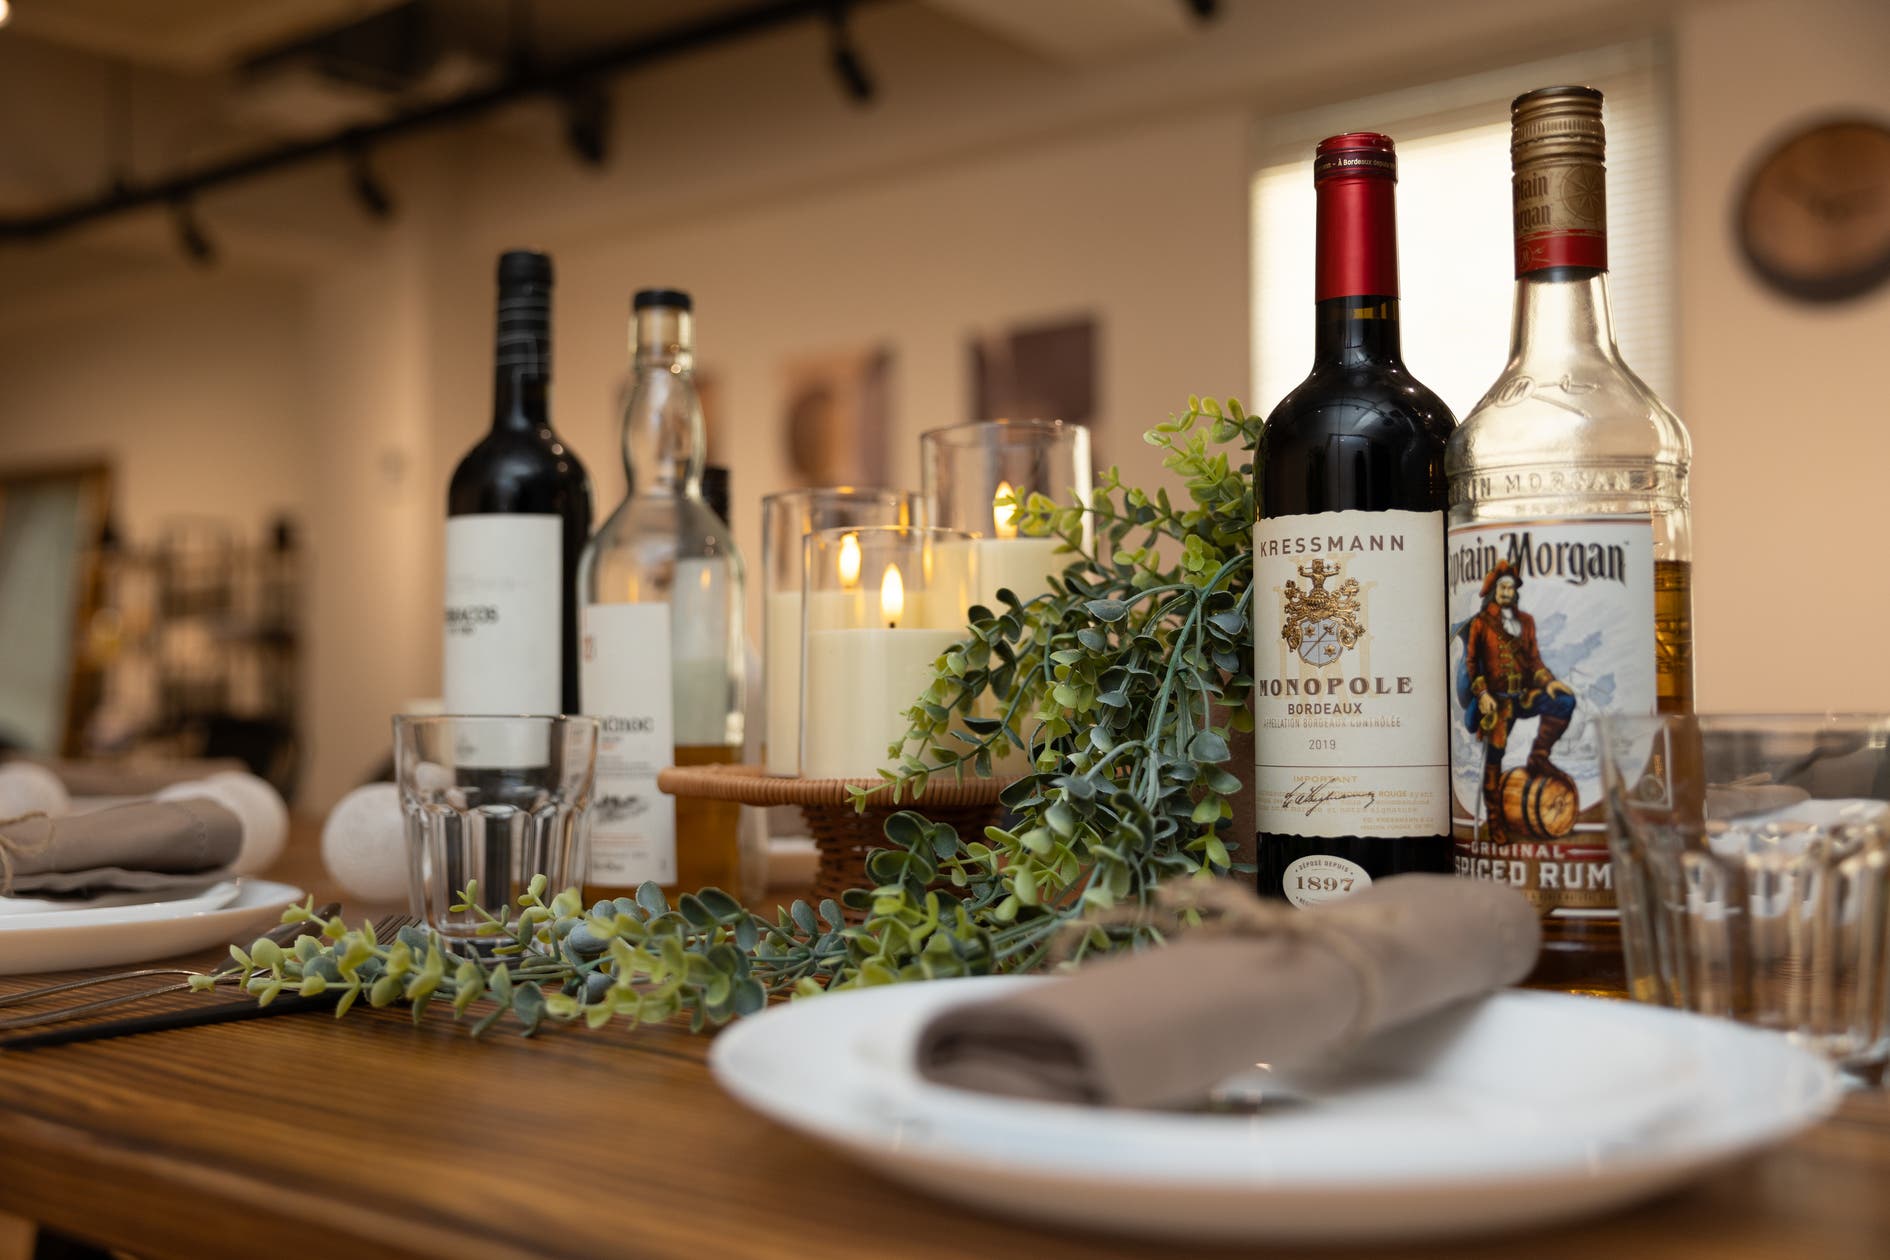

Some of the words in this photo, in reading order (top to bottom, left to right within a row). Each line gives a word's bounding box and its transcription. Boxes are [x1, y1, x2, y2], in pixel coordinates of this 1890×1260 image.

[1343, 158, 1373, 167] Bordeaux
[1517, 172, 1549, 202] tain
[1517, 204, 1552, 232] rgan
[1260, 535, 1405, 558] KRESSMANN
[1449, 535, 1497, 596] ptain
[1500, 531, 1627, 588] Morgan
[1259, 676, 1413, 697] MONOPOLE
[1287, 702, 1363, 715] BORDEAUX
[1263, 717, 1300, 729] APPELLATION
[1303, 717, 1346, 729] BORDEAUX
[1308, 739, 1337, 750] 2019
[1294, 775, 1358, 784] IMPORTANT
[1470, 840, 1566, 859] ORIGINAL
[1454, 855, 1528, 888] SPICED
[1539, 862, 1614, 890] RUM
[1296, 875, 1355, 892] 1897
